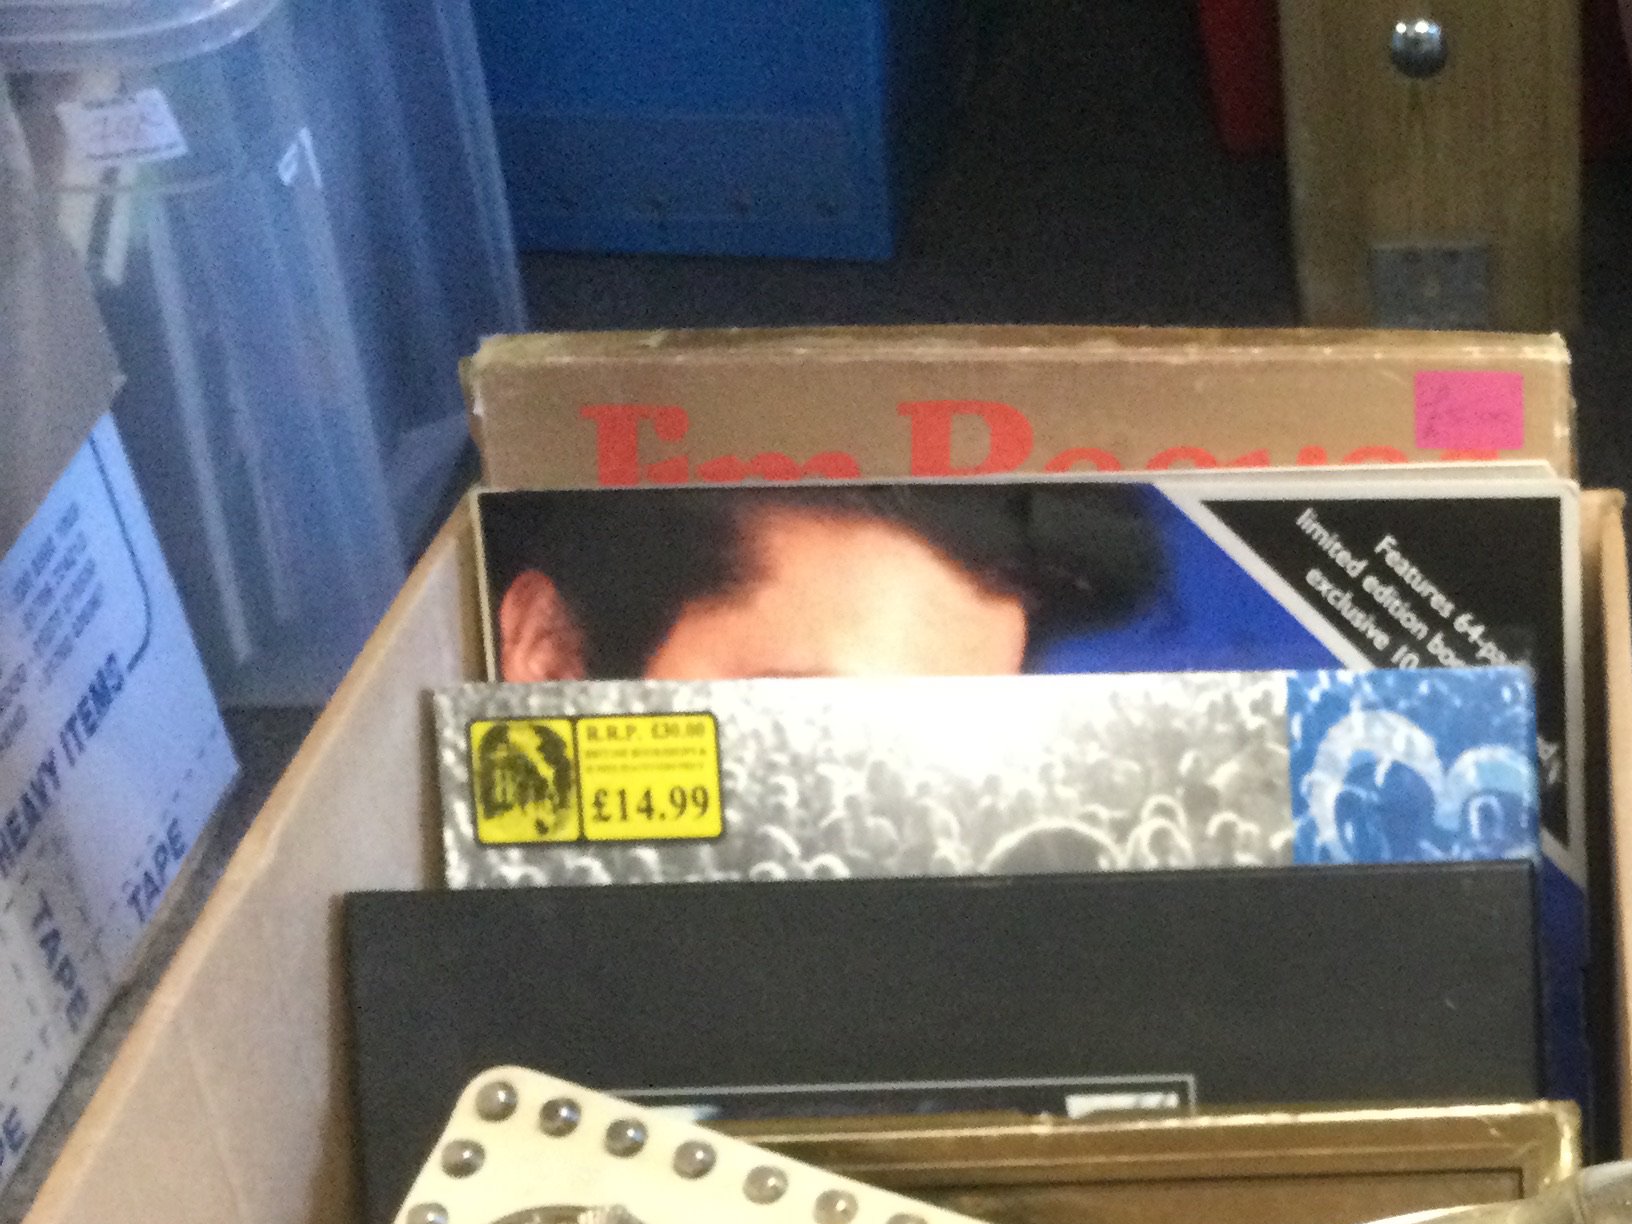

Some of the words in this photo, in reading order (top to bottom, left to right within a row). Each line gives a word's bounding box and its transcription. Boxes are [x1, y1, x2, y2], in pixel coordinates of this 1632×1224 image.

[1296, 507, 1369, 578] limited
[1362, 575, 1430, 641] edition
[1305, 568, 1390, 650] exclusive
[1374, 533, 1456, 618] Features
[59, 650, 127, 767] ITEMS
[592, 784, 710, 822] £14.99
[125, 817, 186, 924] TAPE
[33, 887, 90, 1033] TAPE
